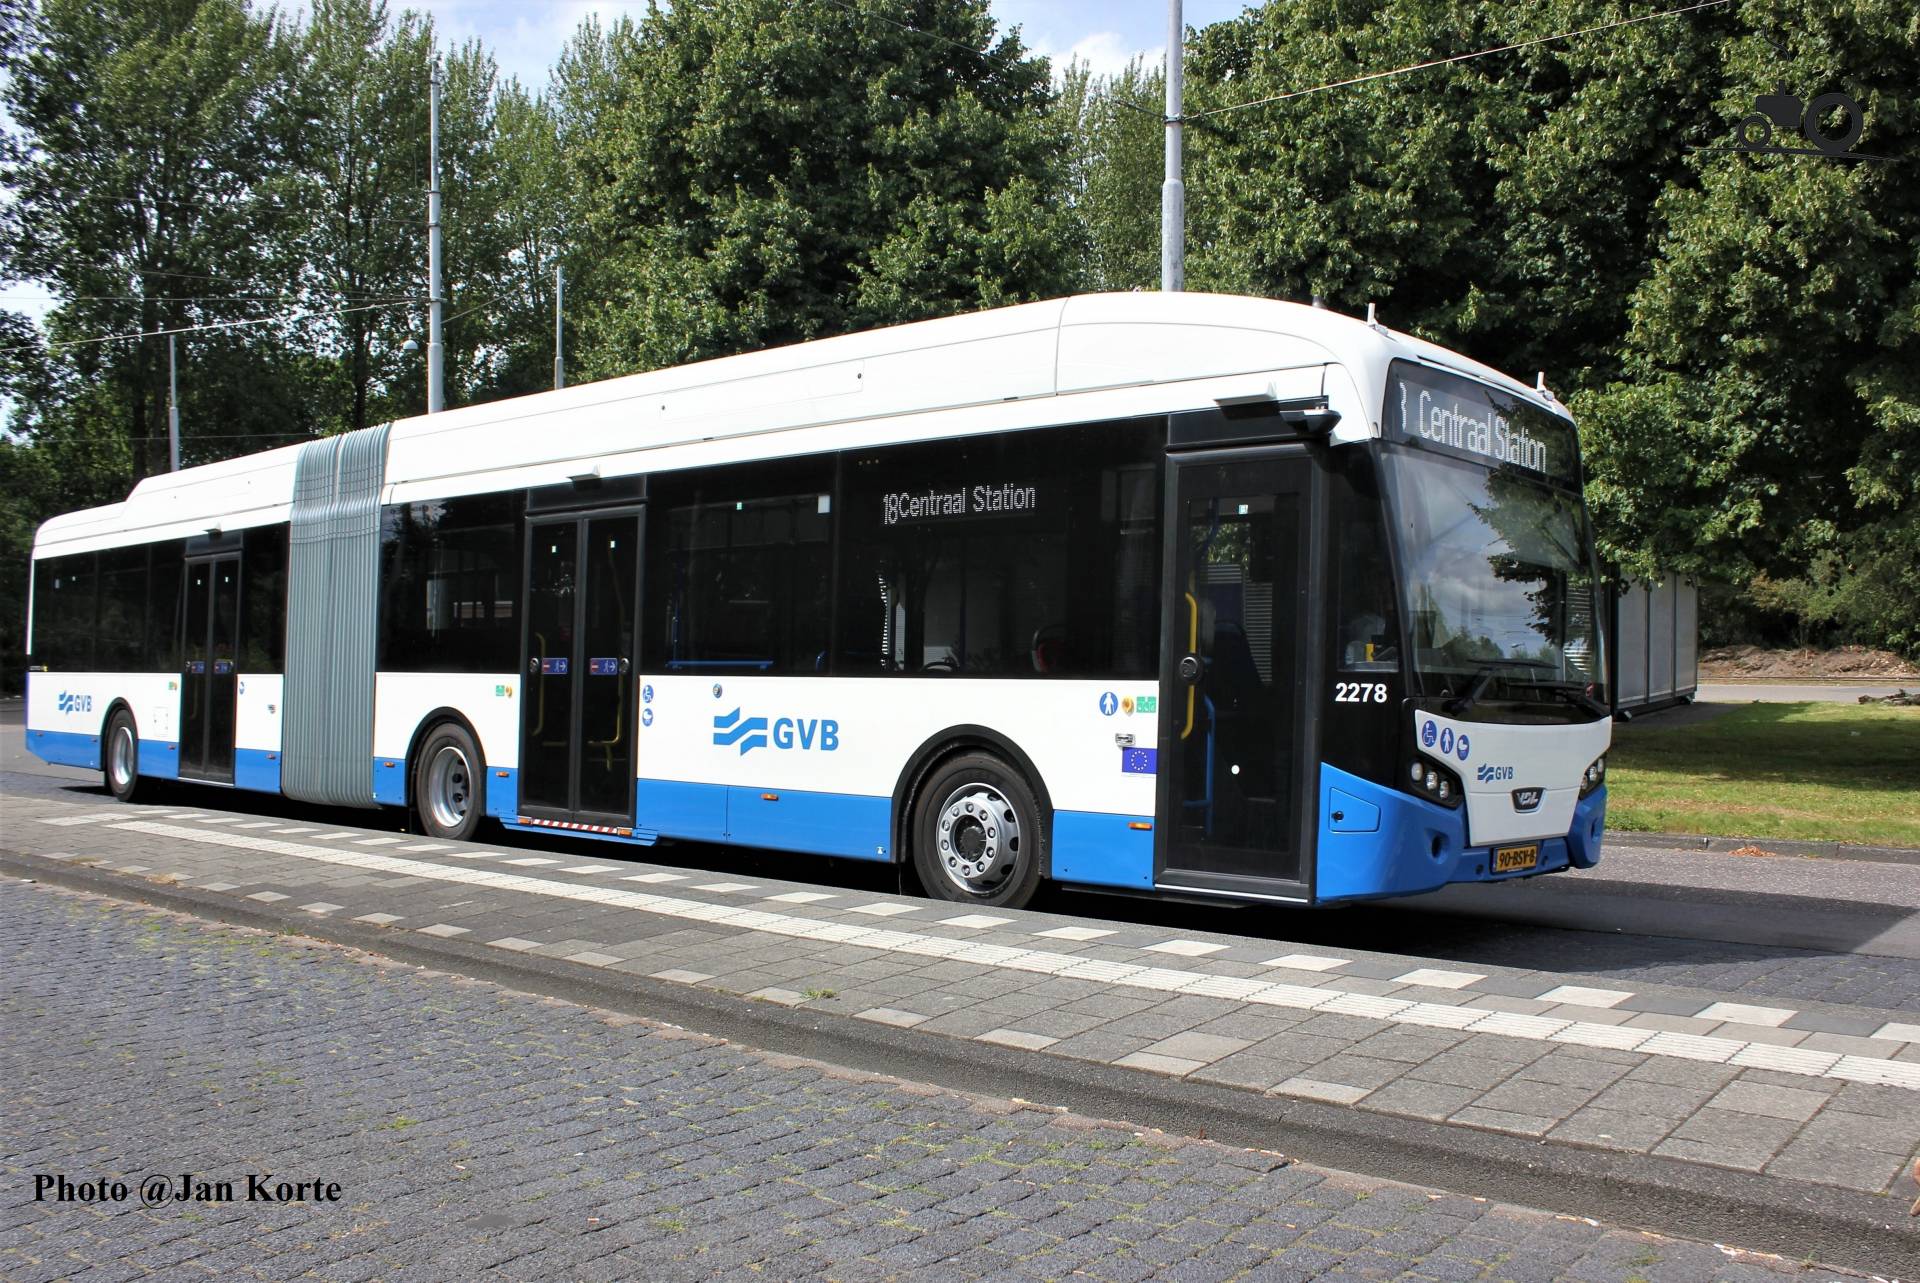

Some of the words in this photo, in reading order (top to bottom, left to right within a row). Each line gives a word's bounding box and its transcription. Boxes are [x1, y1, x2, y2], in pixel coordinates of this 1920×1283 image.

[1420, 390, 1491, 456] Centraal
[1495, 415, 1546, 473] Station
[898, 488, 966, 517] Centraal
[973, 483, 1036, 512] Station
[74, 694, 92, 712] GVB
[1335, 682, 1387, 703] 2278
[773, 717, 839, 751] GVB
[1495, 766, 1513, 780] GVB
